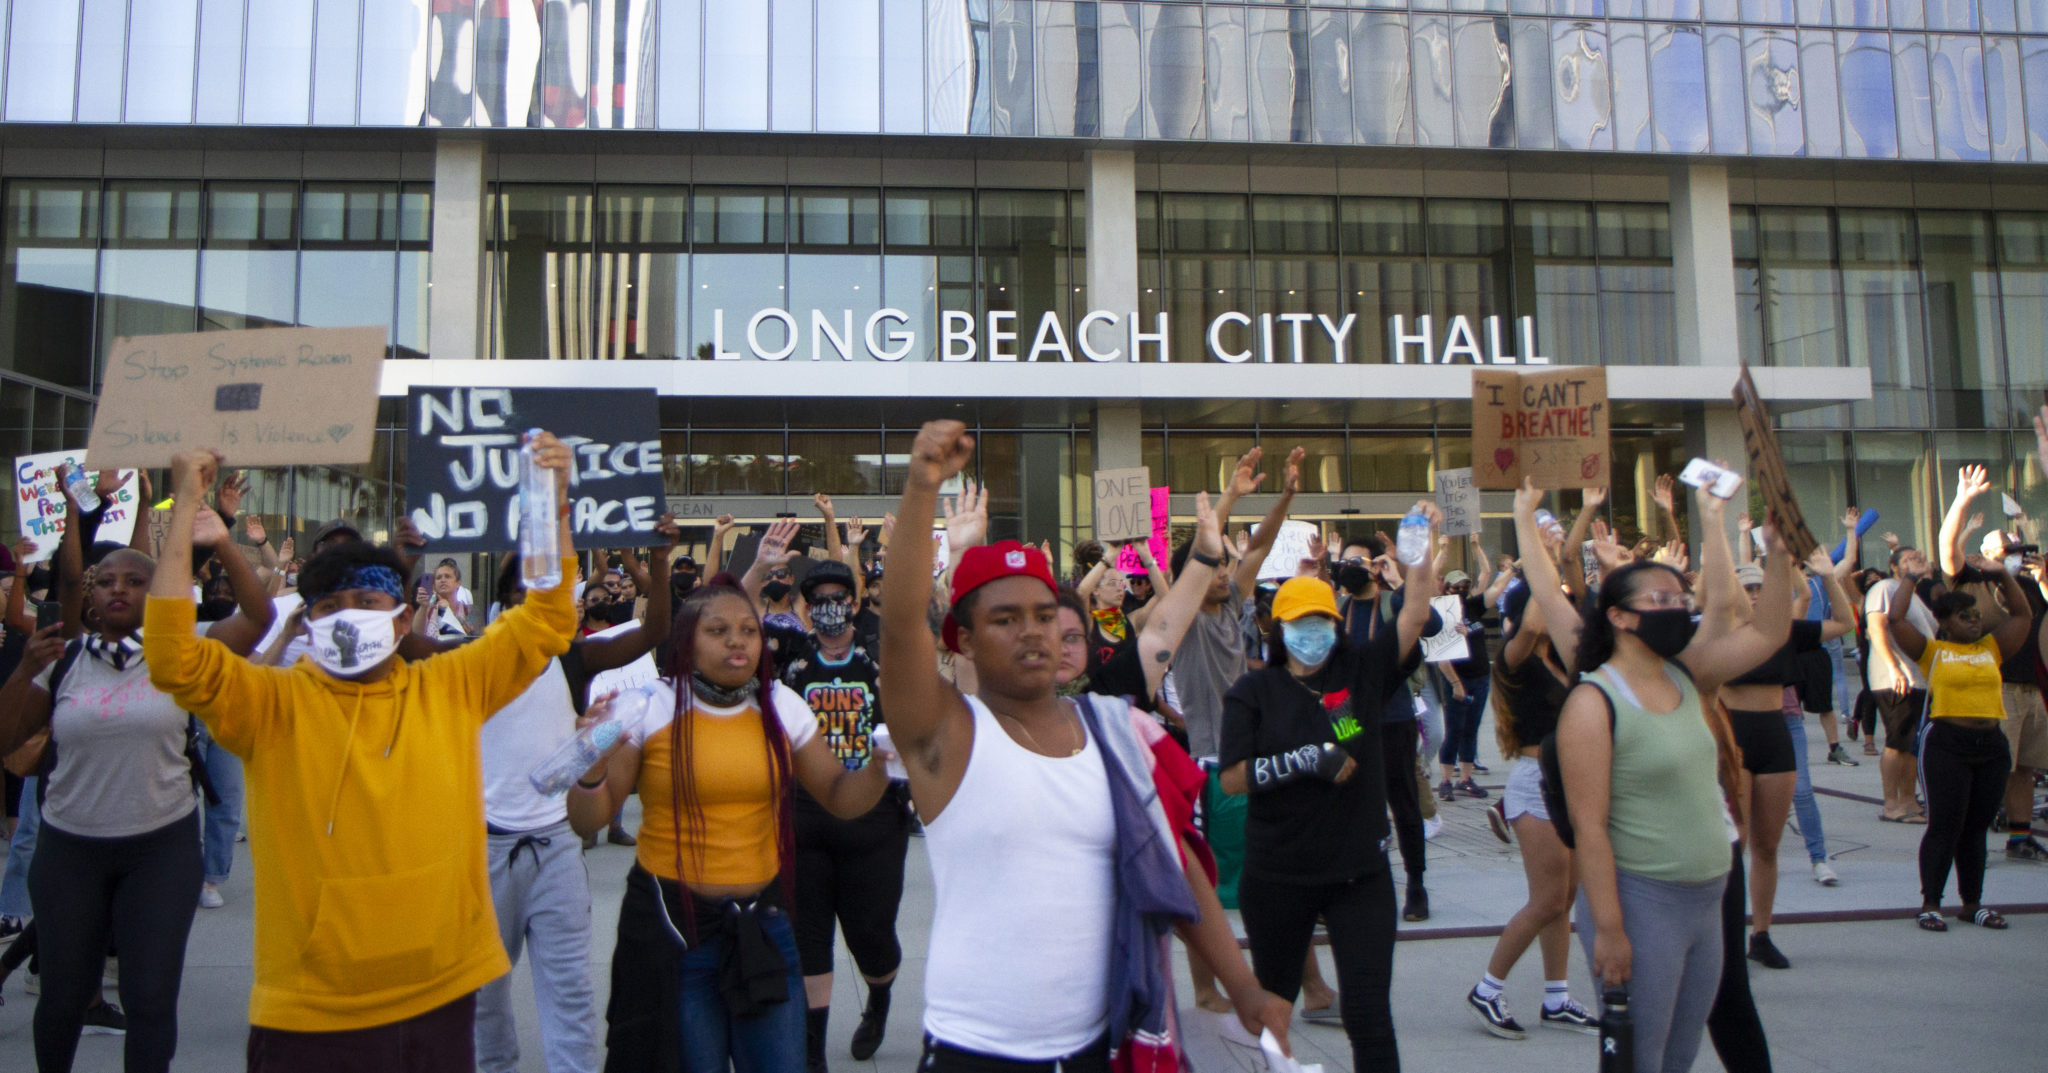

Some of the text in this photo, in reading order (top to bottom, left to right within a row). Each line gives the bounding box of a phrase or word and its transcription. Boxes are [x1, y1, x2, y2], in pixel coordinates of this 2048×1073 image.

[714, 307, 1550, 364] LONG BEACH CITY HALL
[124, 350, 189, 380] Stop
[1523, 379, 1587, 408] CAN'T
[420, 387, 513, 435] NO
[104, 420, 181, 448] Silence
[255, 424, 324, 445] Violence
[440, 434, 663, 491] JUTICE
[1096, 476, 1143, 499] ONE
[412, 492, 656, 541] NO ACE
[666, 503, 713, 515] CEAN
[1098, 502, 1148, 536] LOVE
[808, 687, 865, 711] SUNS
[816, 711, 859, 736] OUT
[1331, 716, 1363, 741] LOVE
[1255, 750, 1304, 784] BLM
